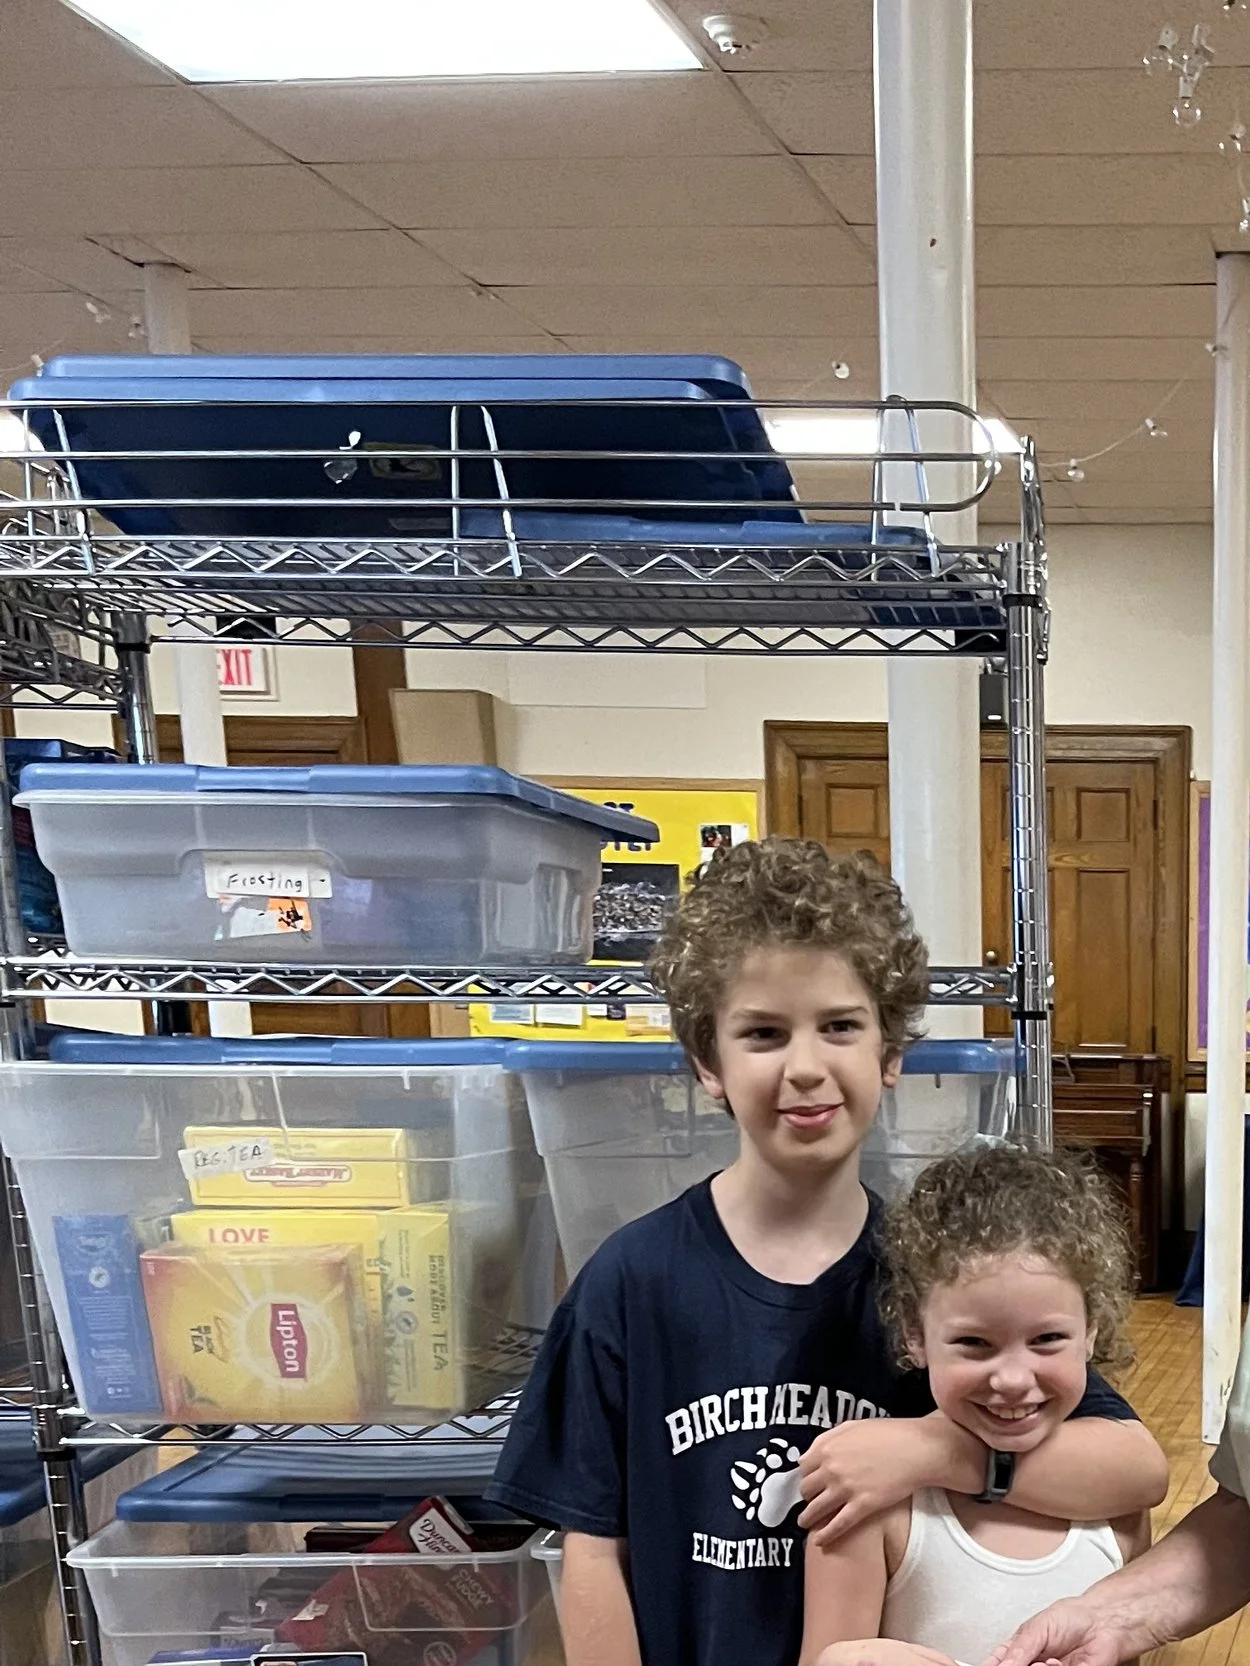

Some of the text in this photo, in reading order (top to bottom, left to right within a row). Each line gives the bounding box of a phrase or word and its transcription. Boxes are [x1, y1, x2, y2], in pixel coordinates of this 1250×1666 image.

[215, 648, 252, 686] XIT
[227, 873, 303, 893] Frosting
[227, 1144, 263, 1166] TEA
[209, 1228, 270, 1244] LOVE
[190, 1326, 204, 1354] TEA
[276, 1310, 300, 1372] Lipton
[432, 1330, 449, 1371] TEA
[665, 1386, 769, 1456] BIRCH
[418, 1532, 446, 1552] Hin
[692, 1532, 794, 1571] ELEMENTARY
